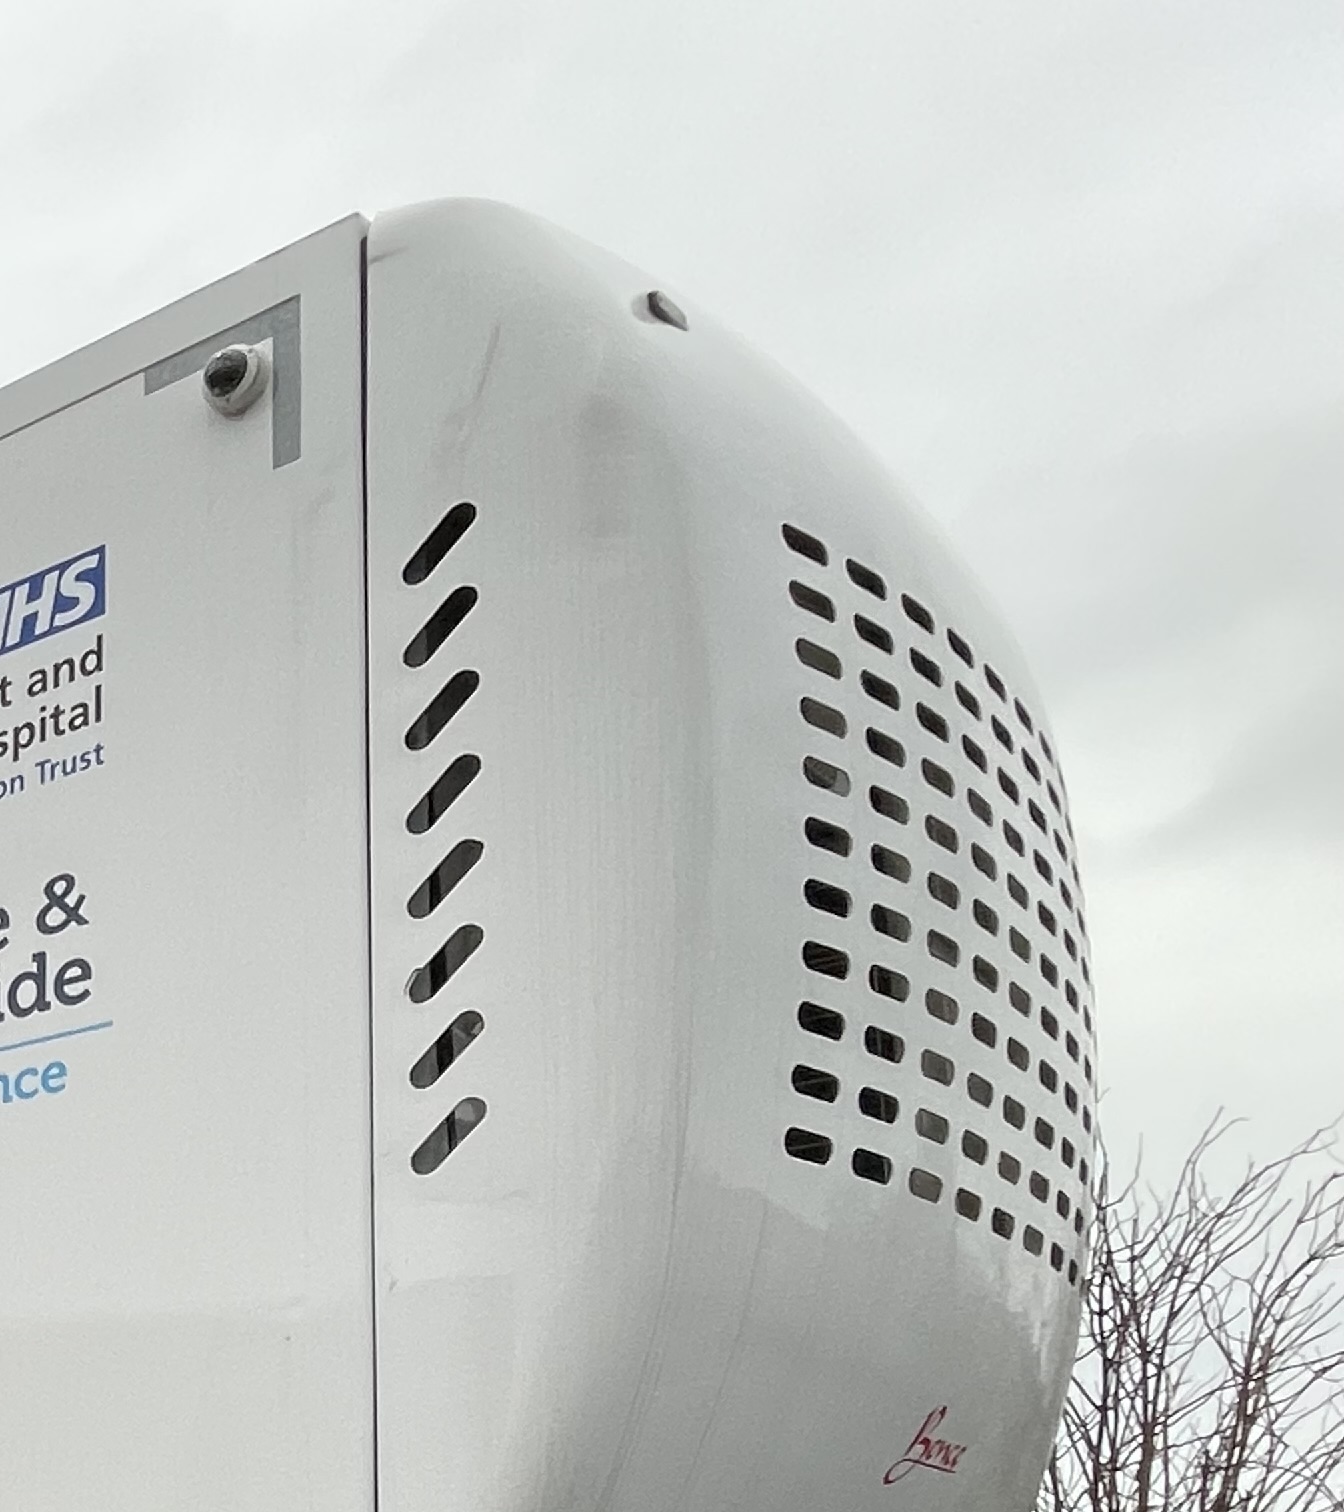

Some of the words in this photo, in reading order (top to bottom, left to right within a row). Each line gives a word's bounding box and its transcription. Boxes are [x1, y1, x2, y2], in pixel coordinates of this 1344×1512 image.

[26, 633, 104, 698] and
[34, 741, 105, 786] Trust
[35, 872, 90, 935] &
